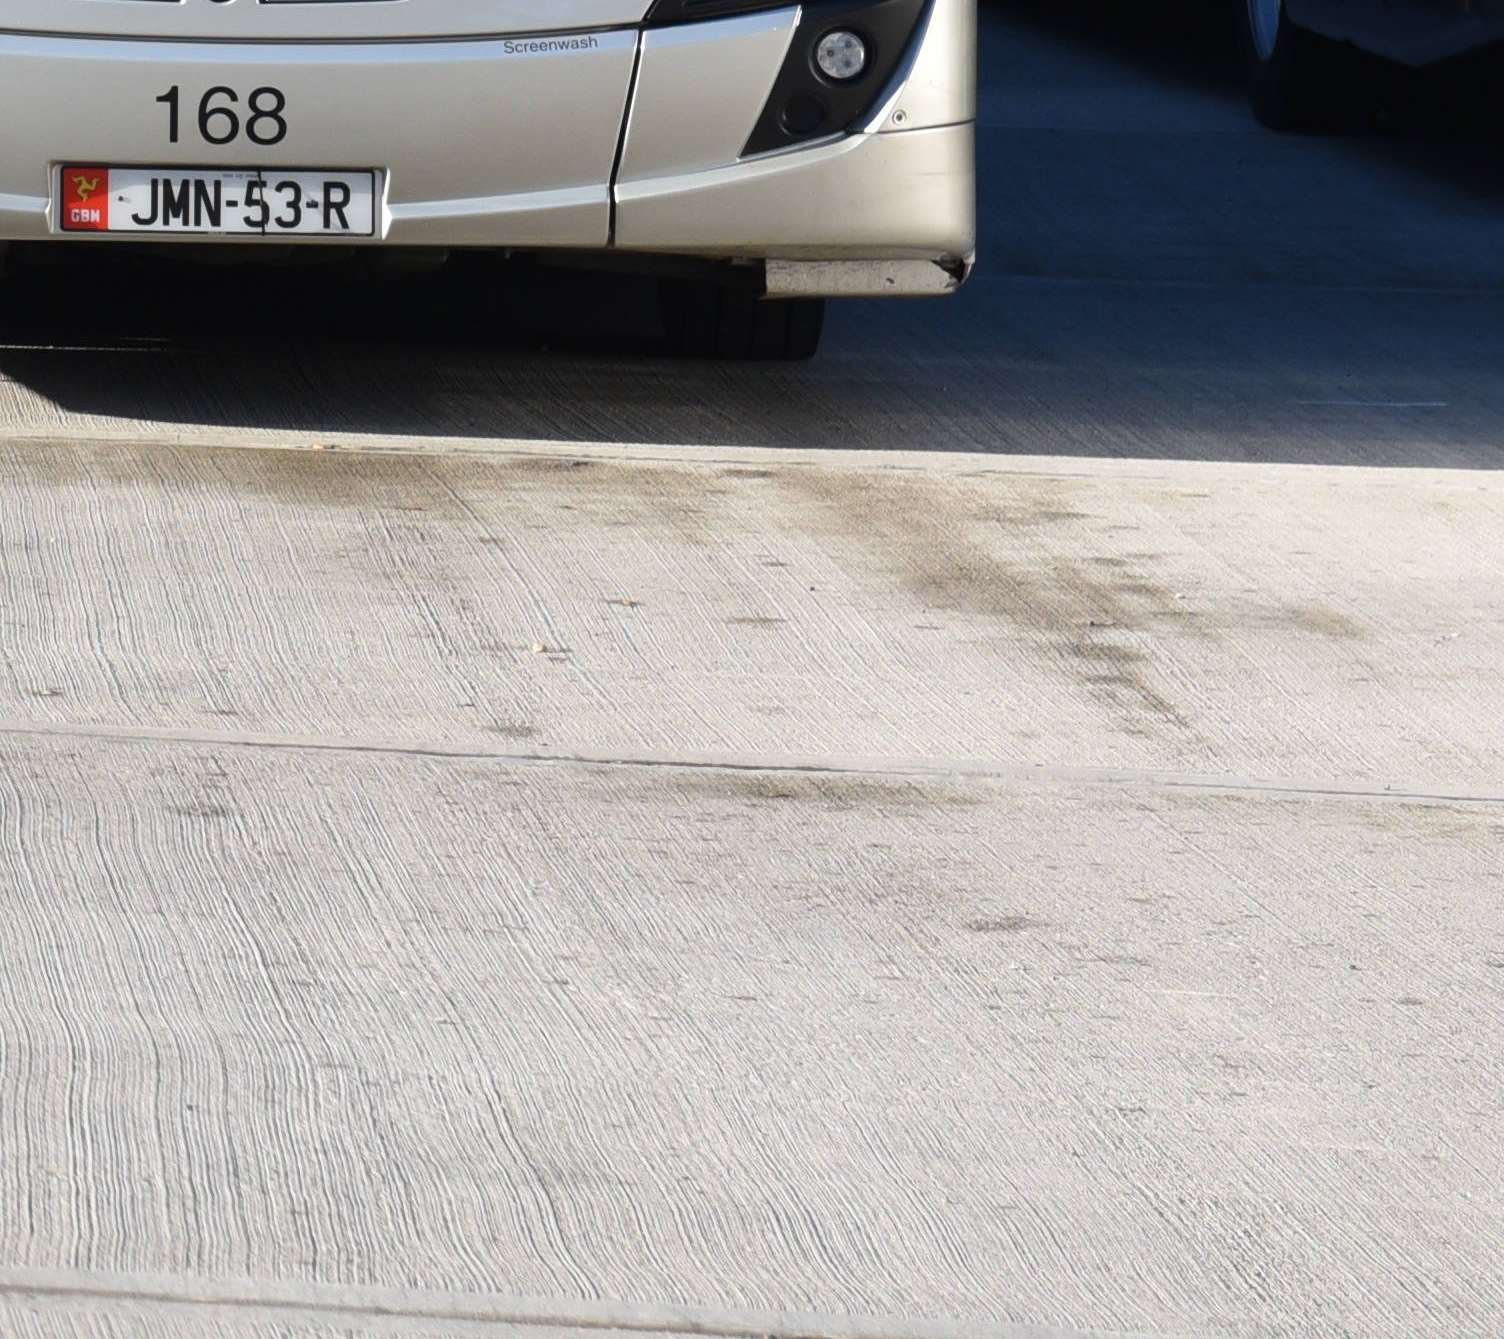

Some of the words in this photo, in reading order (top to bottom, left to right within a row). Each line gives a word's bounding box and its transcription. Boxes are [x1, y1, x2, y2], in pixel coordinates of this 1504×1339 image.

[503, 35, 599, 55] Screenwash
[156, 85, 288, 146] 168
[70, 208, 100, 223] GBM
[131, 178, 351, 230] JMN-53-R
